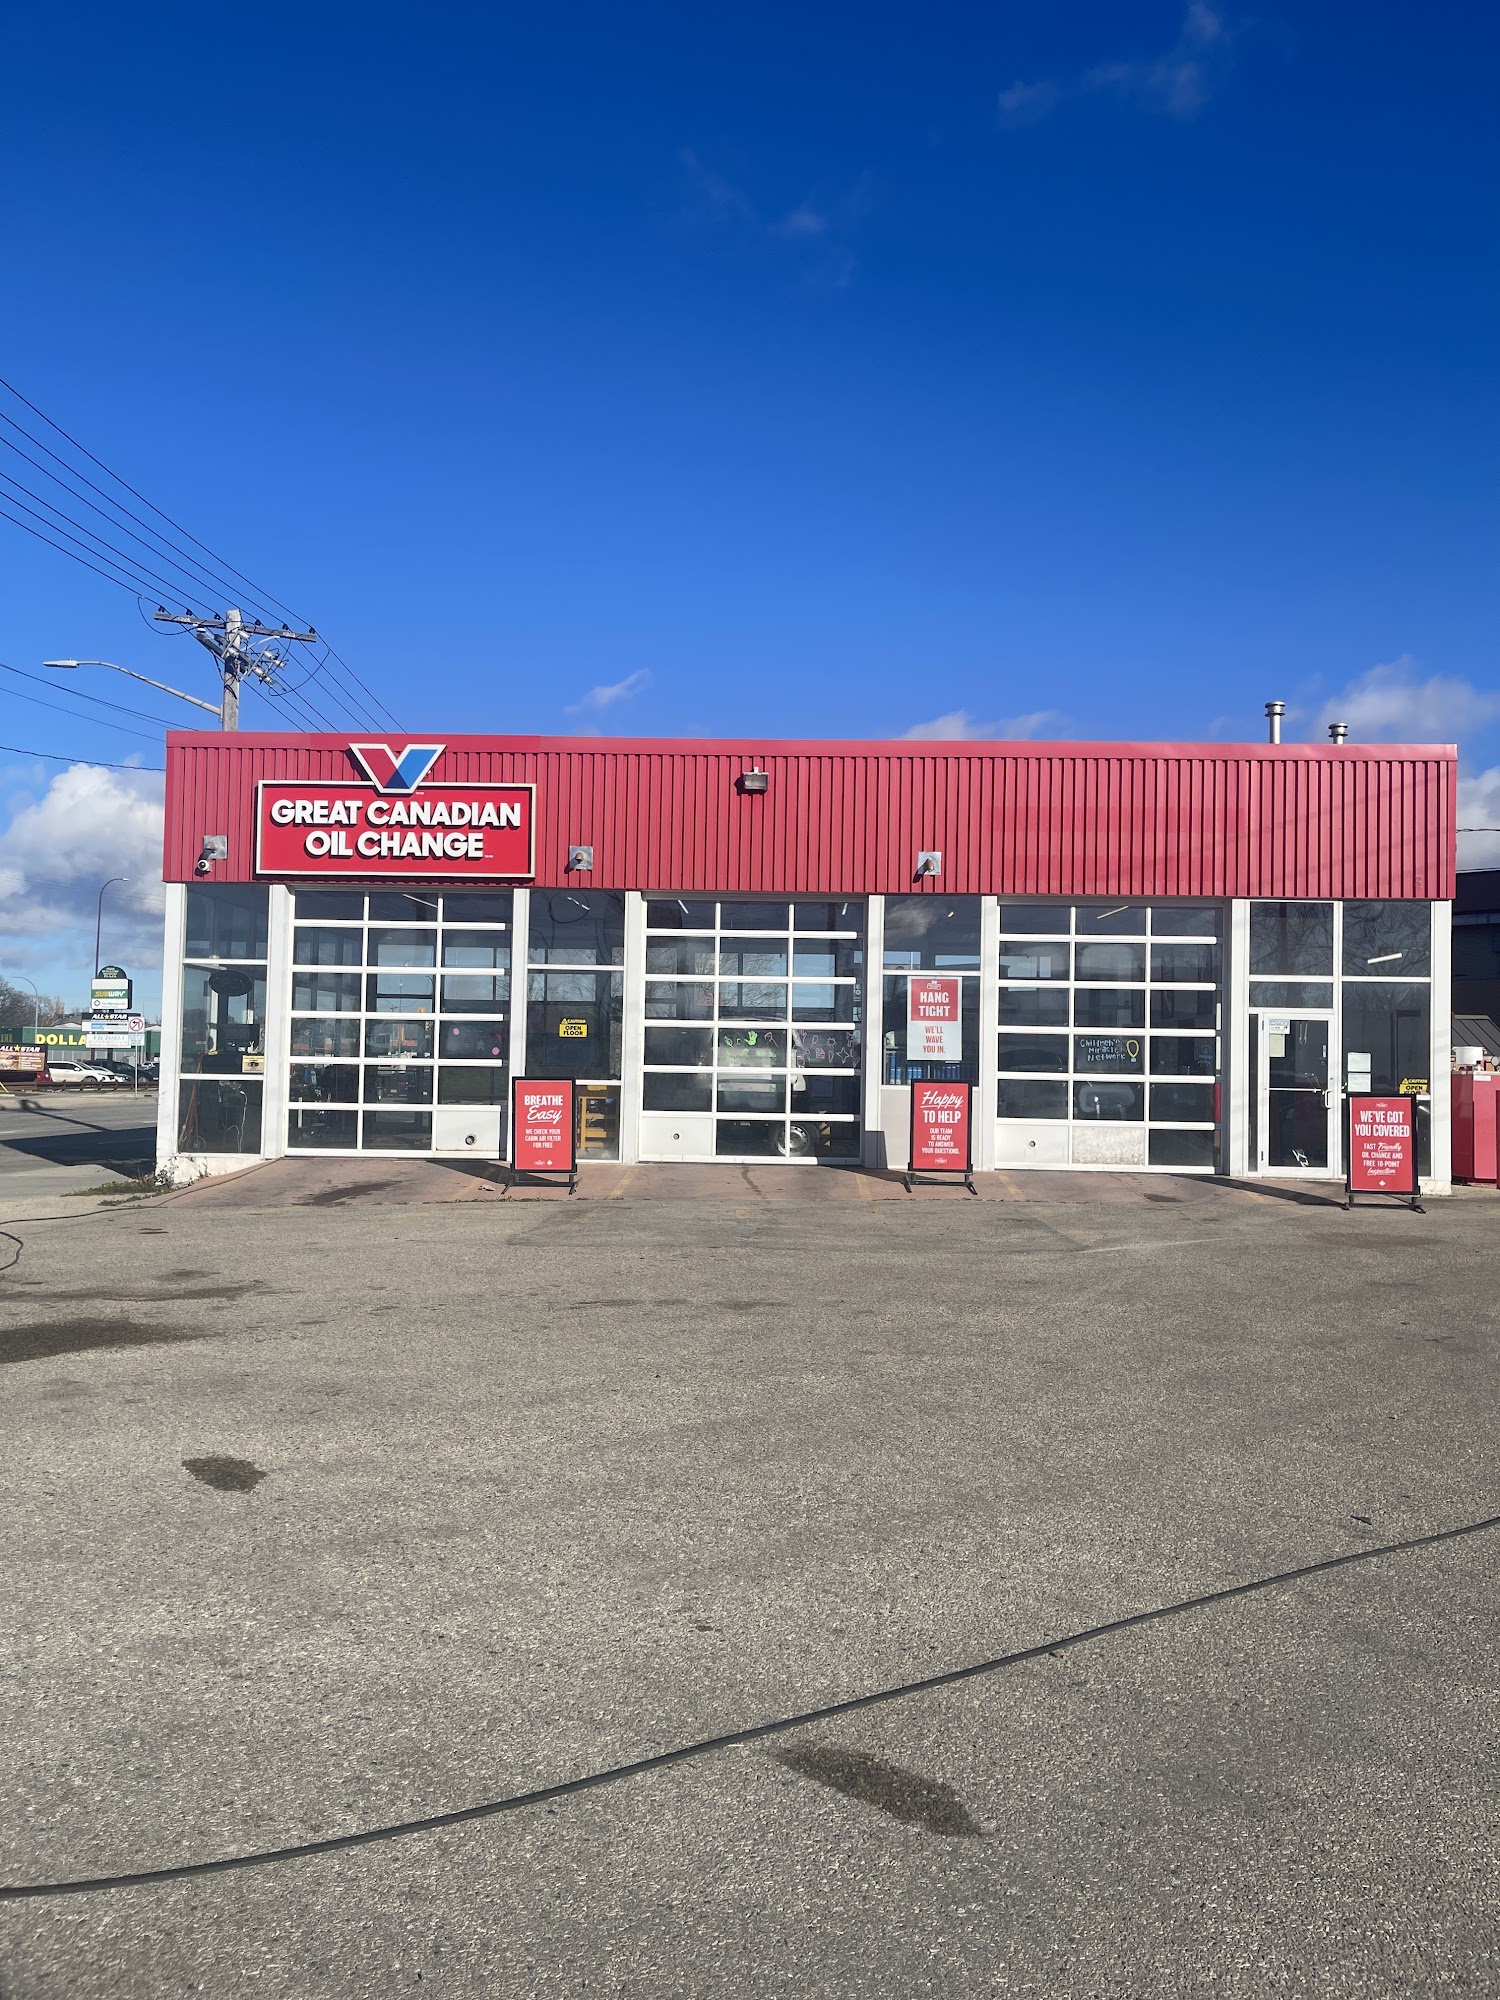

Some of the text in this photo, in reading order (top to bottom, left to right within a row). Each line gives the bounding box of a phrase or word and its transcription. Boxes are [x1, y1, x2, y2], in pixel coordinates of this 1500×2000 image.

[271, 800, 521, 827] GREAT CANADIAN
[305, 831, 483, 858] OIL CHANGE
[920, 992, 949, 1003] HANG
[918, 1006, 950, 1017] TIGHT
[524, 1095, 563, 1106] BREATHE
[922, 1091, 963, 1109] Happy
[527, 1105, 562, 1124] Easy
[923, 1110, 961, 1123] TO HELP
[1360, 1111, 1404, 1123] WE'VE GOT
[1355, 1124, 1410, 1137] YOU COVERED
[1378, 1142, 1401, 1151] Friendly
[1367, 1167, 1396, 1175] Inspection
